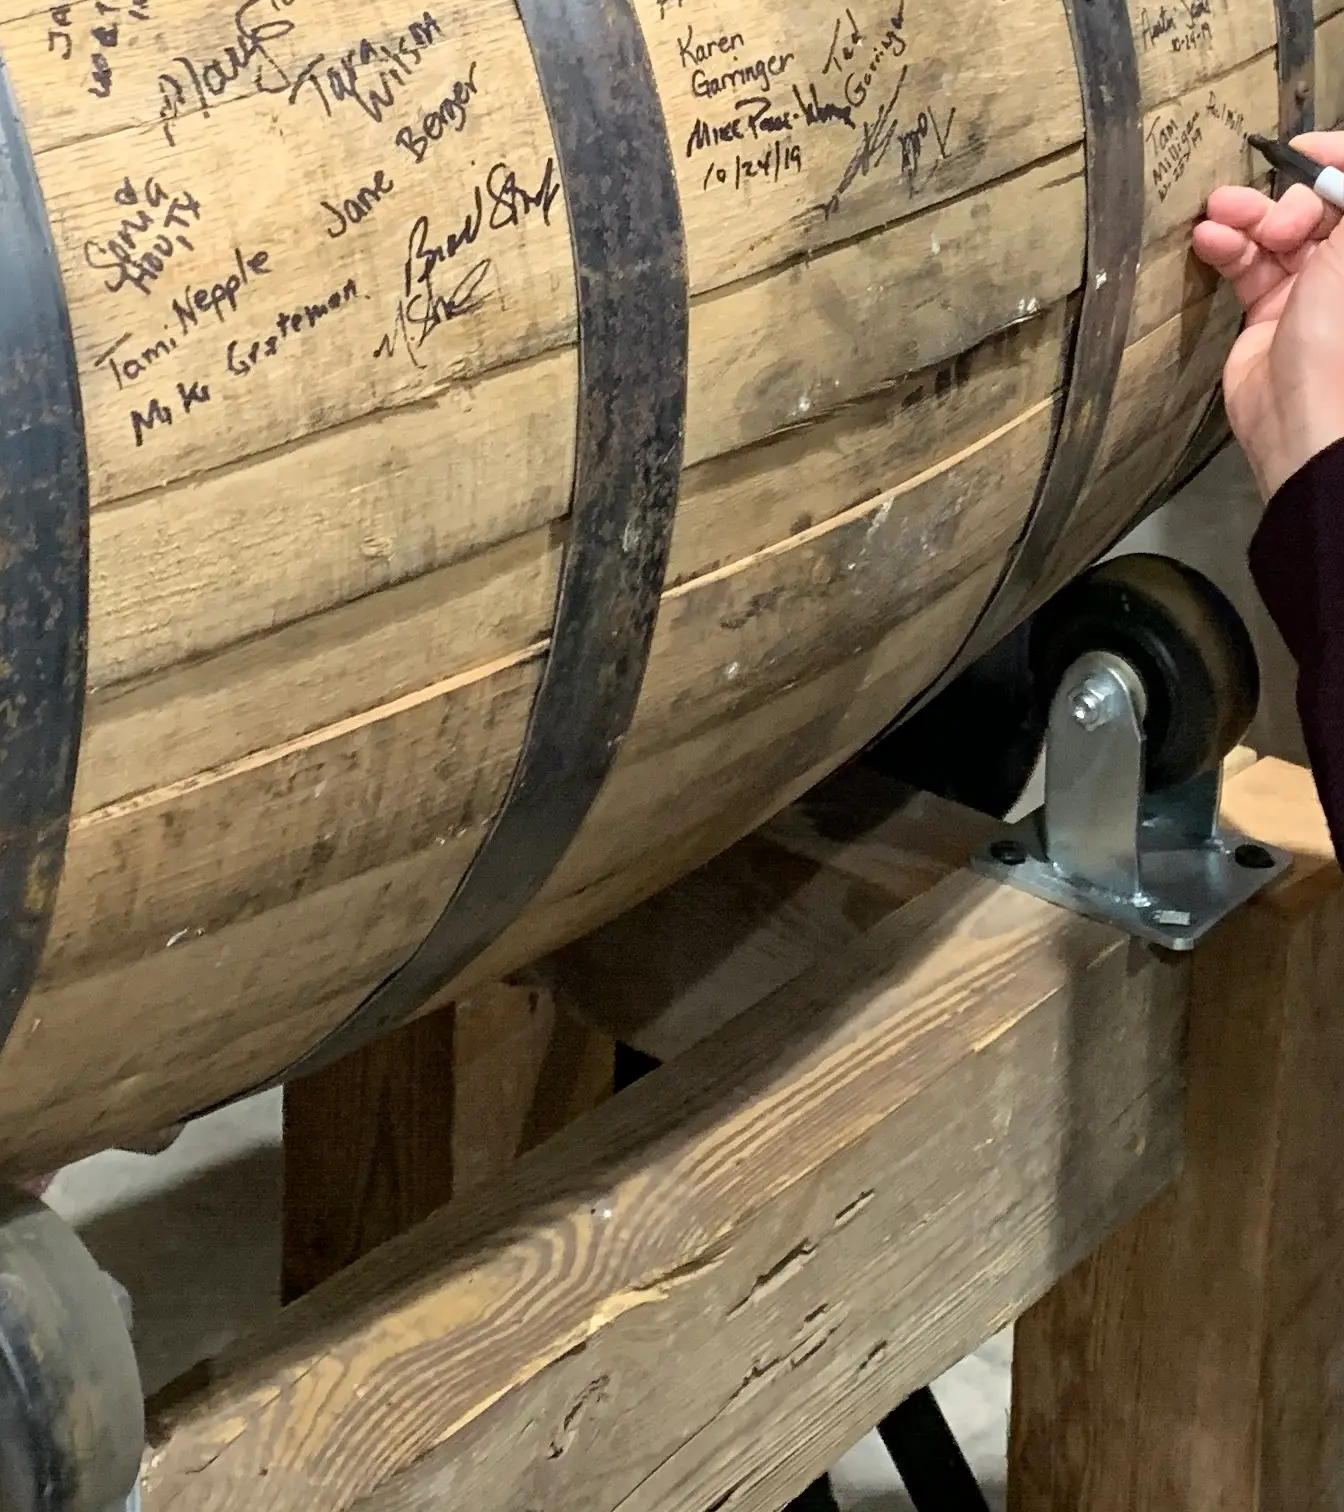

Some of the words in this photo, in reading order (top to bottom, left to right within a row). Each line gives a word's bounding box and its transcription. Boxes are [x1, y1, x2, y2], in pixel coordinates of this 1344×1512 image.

[677, 25, 744, 68] Karen
[822, 8, 862, 75] Ted
[690, 51, 795, 99] Garringer
[318, 169, 394, 239] Jane
